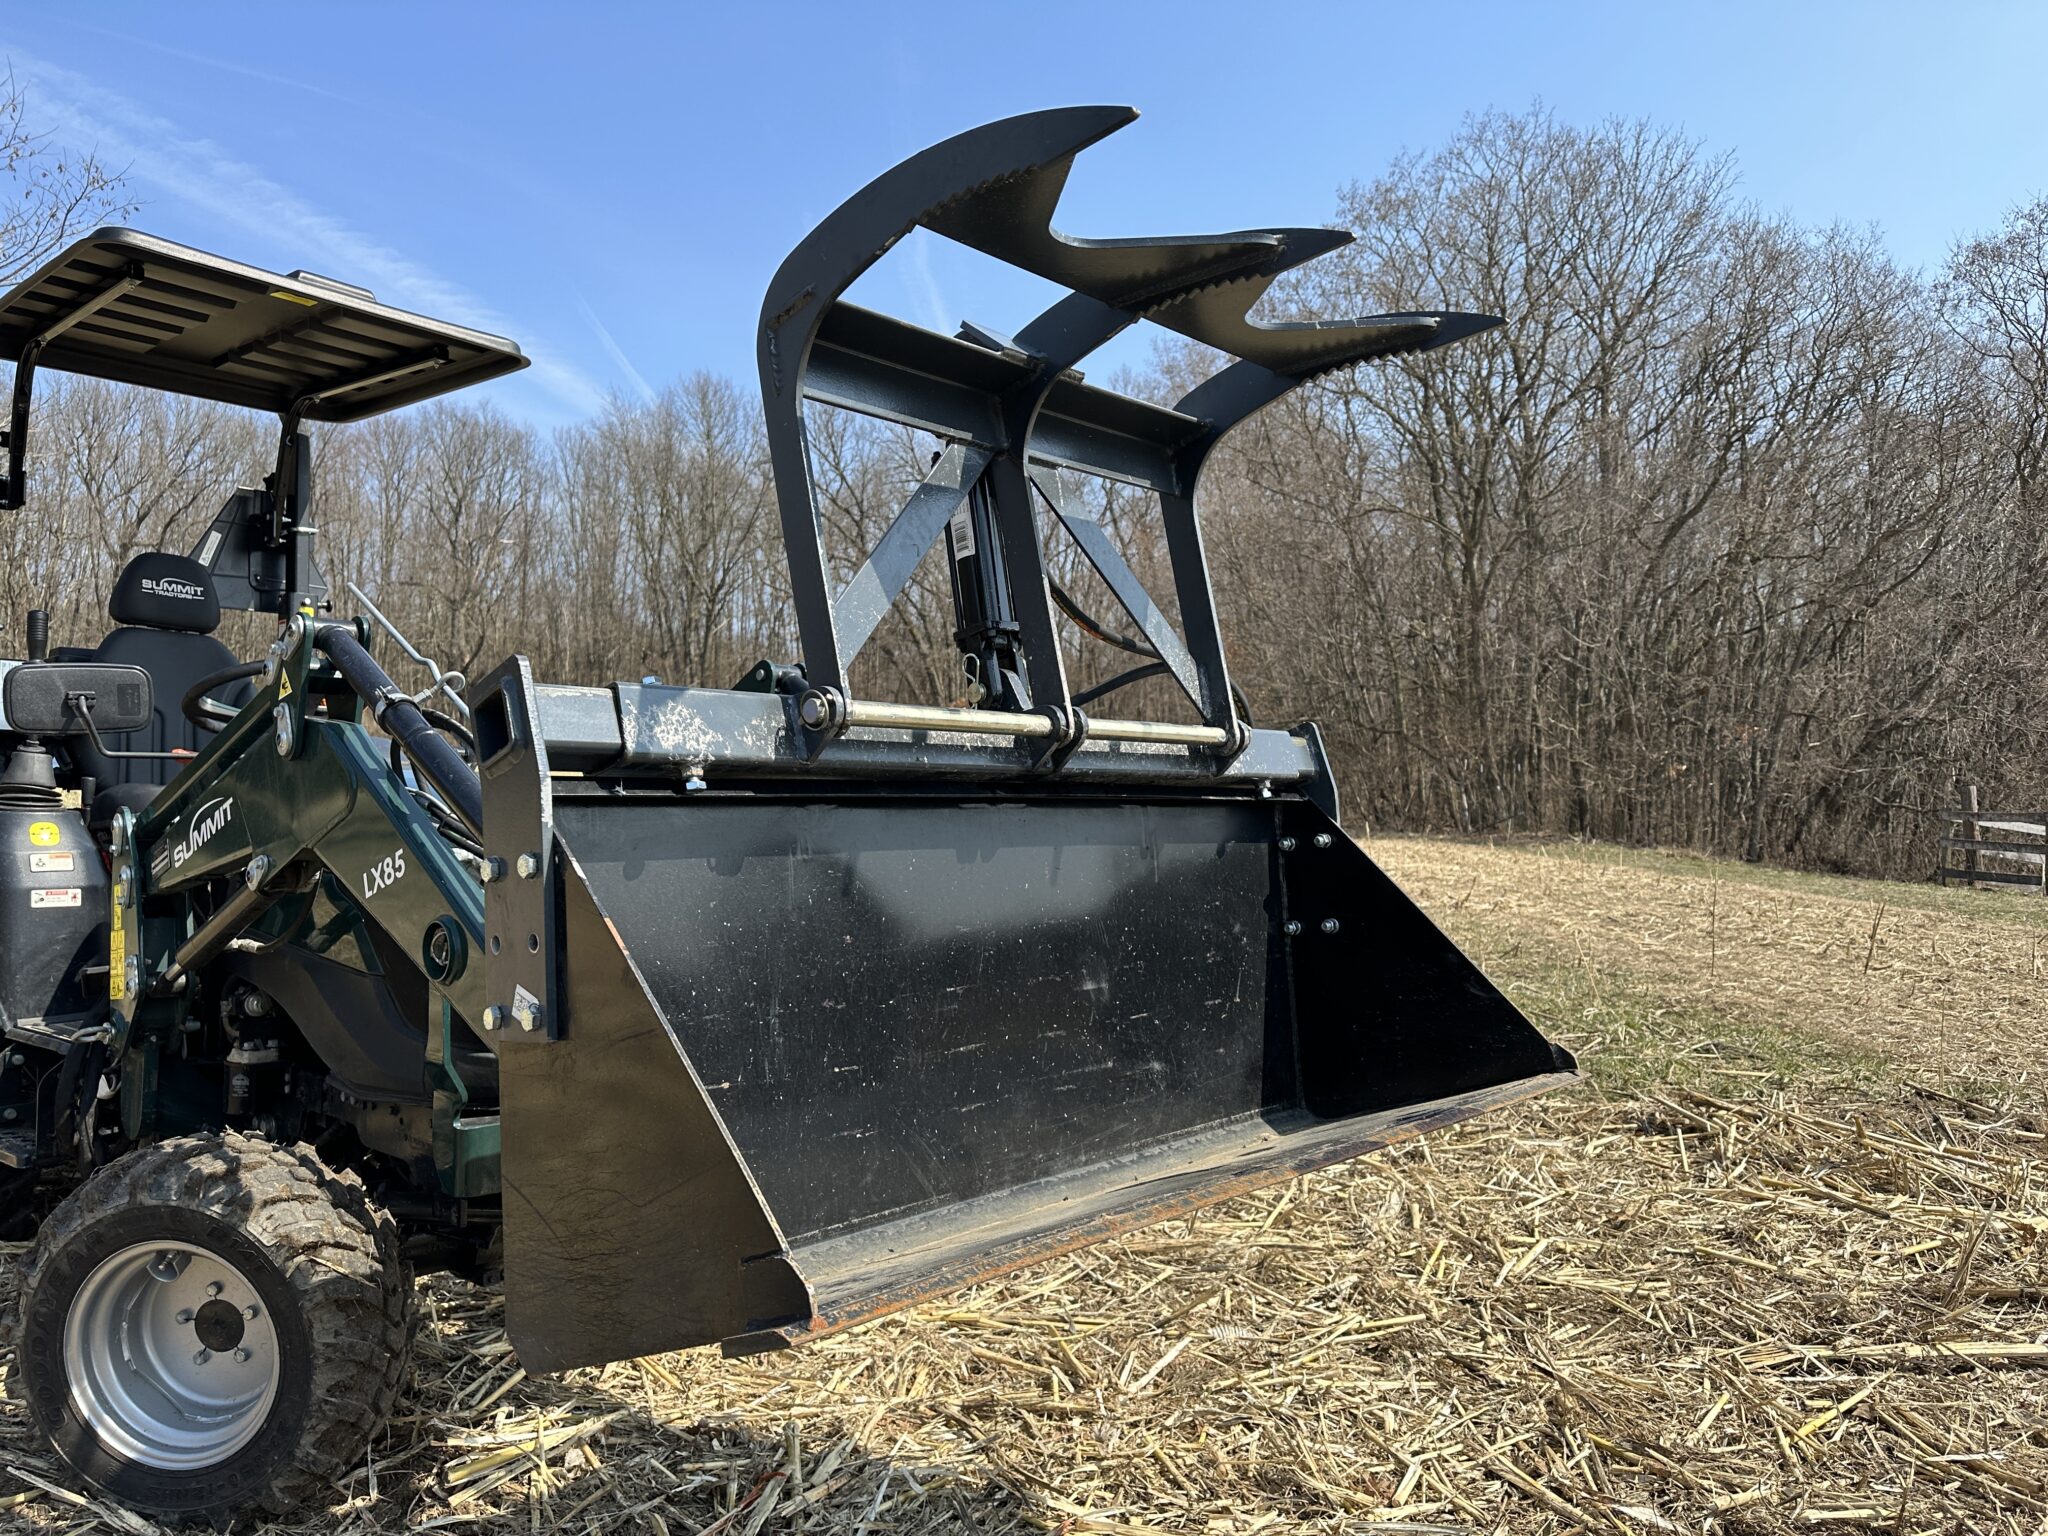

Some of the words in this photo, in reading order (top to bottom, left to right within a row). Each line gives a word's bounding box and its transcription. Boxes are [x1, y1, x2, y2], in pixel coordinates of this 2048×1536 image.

[142, 578, 204, 596] SUMMIT
[155, 589, 193, 600] TRACTORS
[173, 796, 234, 869] SUMMIT
[362, 847, 406, 899] LX85
[31, 1227, 106, 1430] GOODYEAR
